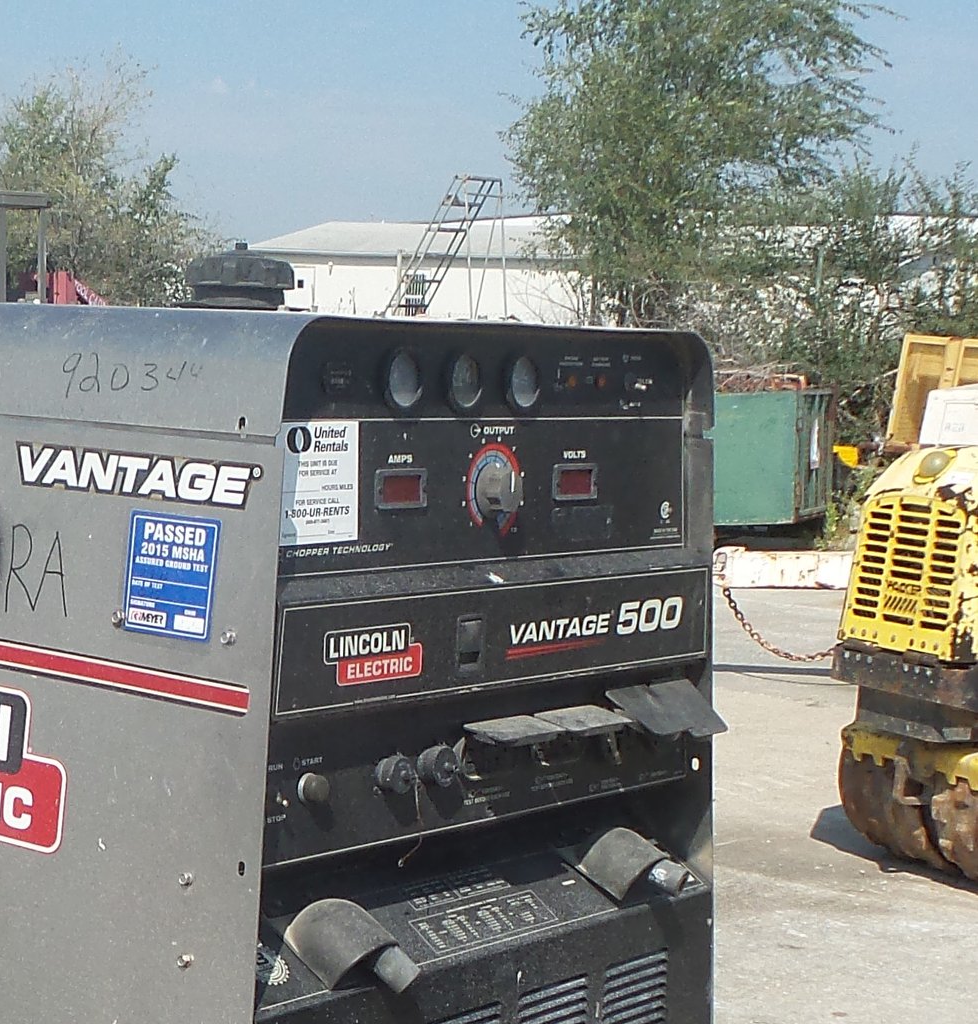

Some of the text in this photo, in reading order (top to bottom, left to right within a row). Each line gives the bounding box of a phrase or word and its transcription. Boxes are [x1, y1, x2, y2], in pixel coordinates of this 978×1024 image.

[314, 426, 346, 439] United
[483, 426, 514, 435] OUTPUT
[313, 441, 349, 453] Rentals
[563, 450, 586, 459] VOLTS
[388, 454, 413, 464] AMPS
[144, 522, 206, 546] PASSED
[141, 542, 205, 562] 2015 MSHA
[286, 543, 391, 558] CHOPPER TECHNOLOGY
[4, 523, 68, 618] RA
[135, 556, 208, 573] ASSURED GROUND TEST
[509, 596, 684, 645] VANTAGE 500
[329, 629, 405, 659] LINCOLN
[347, 656, 413, 680] ELECTRIC
[268, 763, 284, 771] RUN
[302, 756, 323, 766] START
